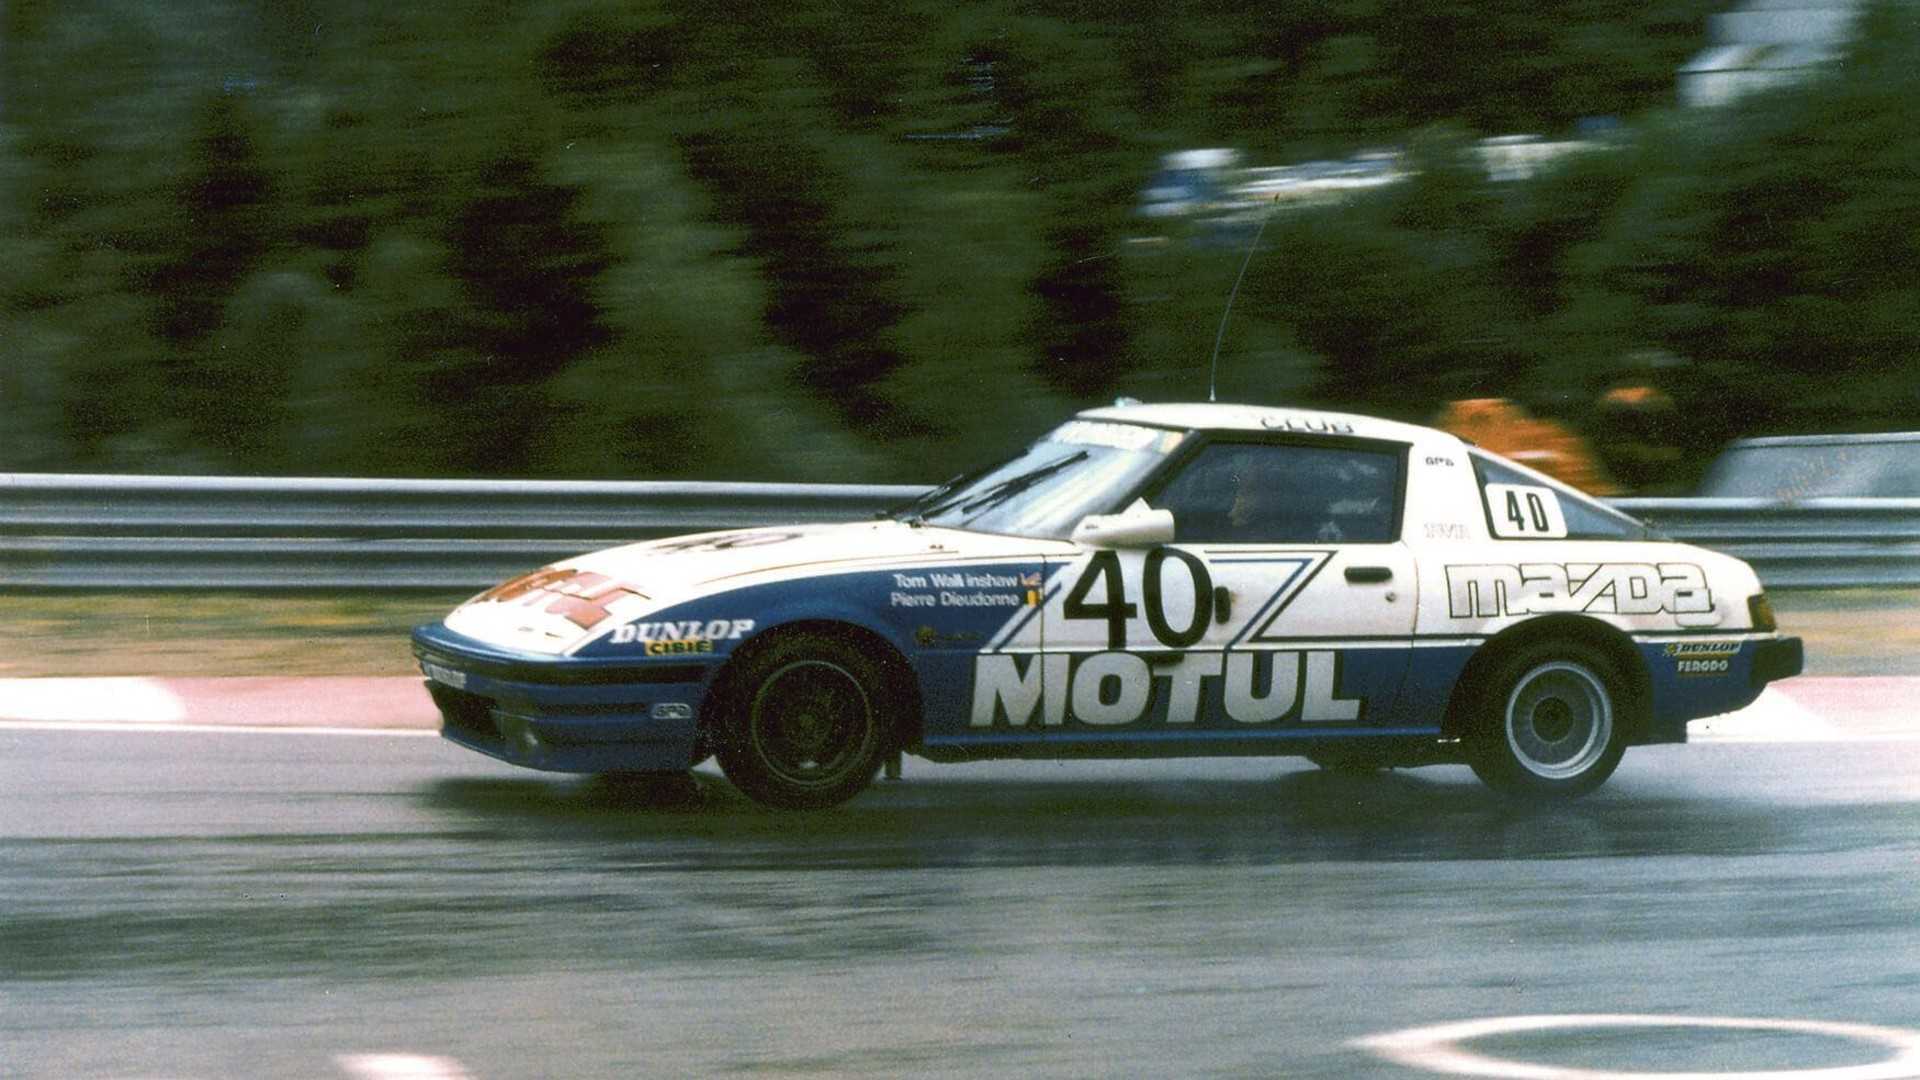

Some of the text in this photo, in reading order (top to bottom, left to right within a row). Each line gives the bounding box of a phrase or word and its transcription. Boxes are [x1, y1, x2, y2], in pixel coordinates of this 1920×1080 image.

[1506, 490, 1549, 533] 40
[893, 573, 927, 588] Tom
[890, 591, 1020, 607] Pierre Dieudonne
[1063, 547, 1214, 651] 40
[609, 619, 756, 643] DUNLOP
[1680, 642, 1739, 653] DUNLOP
[968, 650, 1362, 727] MOTUL
